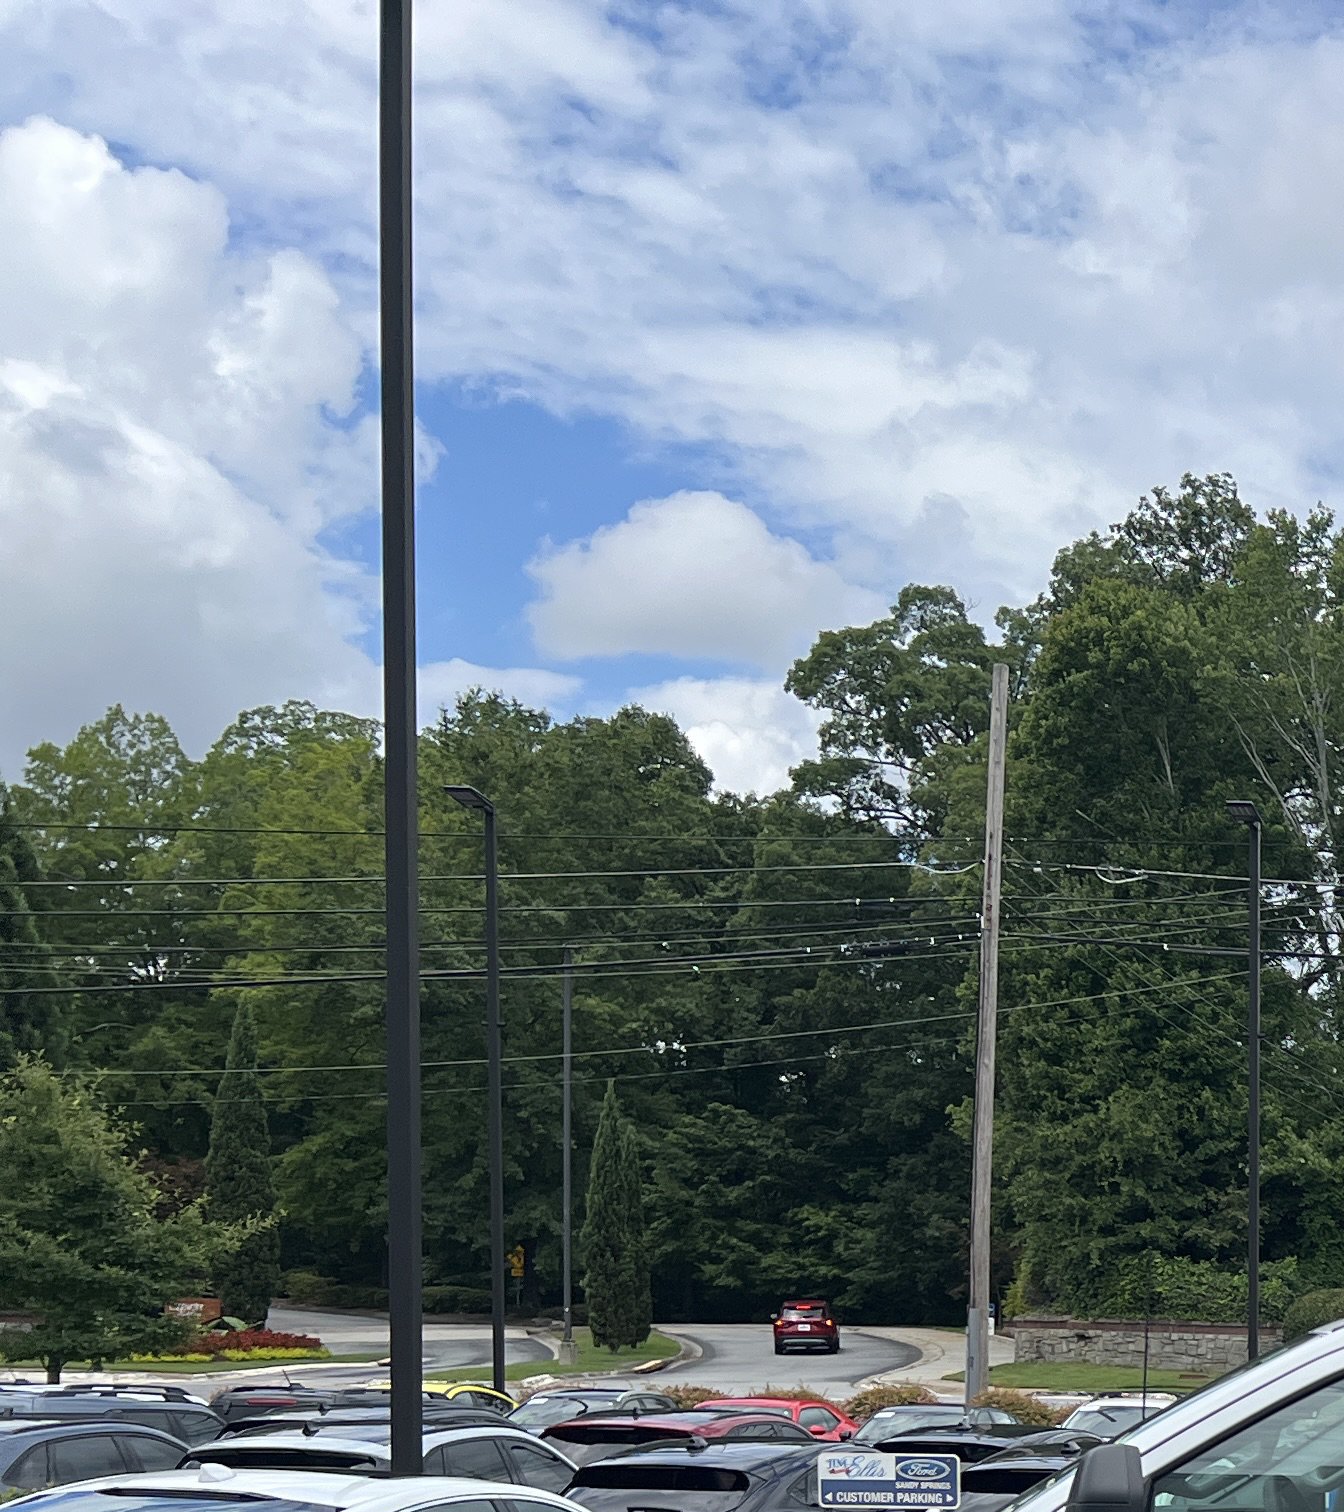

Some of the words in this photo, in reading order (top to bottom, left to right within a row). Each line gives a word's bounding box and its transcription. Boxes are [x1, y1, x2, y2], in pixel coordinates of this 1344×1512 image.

[828, 1458, 848, 1468] JIM
[847, 1455, 887, 1478] Ellis
[907, 1462, 938, 1476] Ford
[836, 1491, 894, 1503] CUSTOMER
[897, 1492, 943, 1504] PARKING
